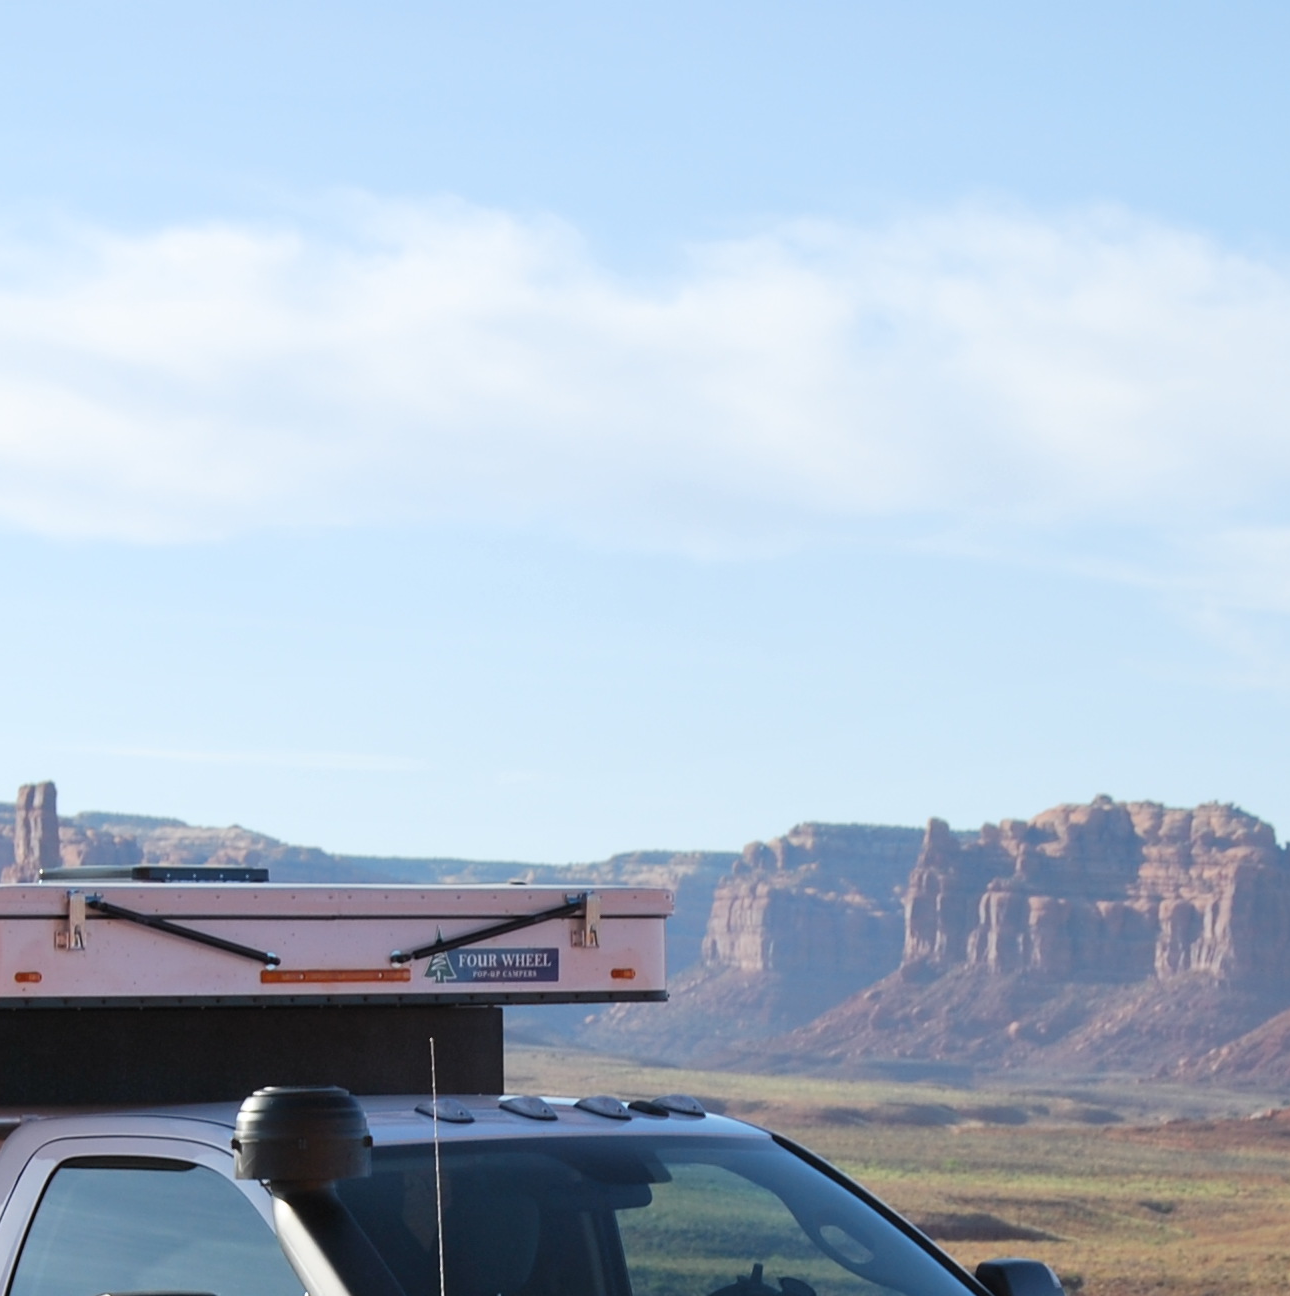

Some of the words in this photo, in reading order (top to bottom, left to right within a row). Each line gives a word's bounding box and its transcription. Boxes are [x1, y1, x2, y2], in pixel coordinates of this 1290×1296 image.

[459, 954, 498, 968] FOUR
[502, 953, 552, 967] WHEEL
[502, 970, 537, 978] CAMPERS
